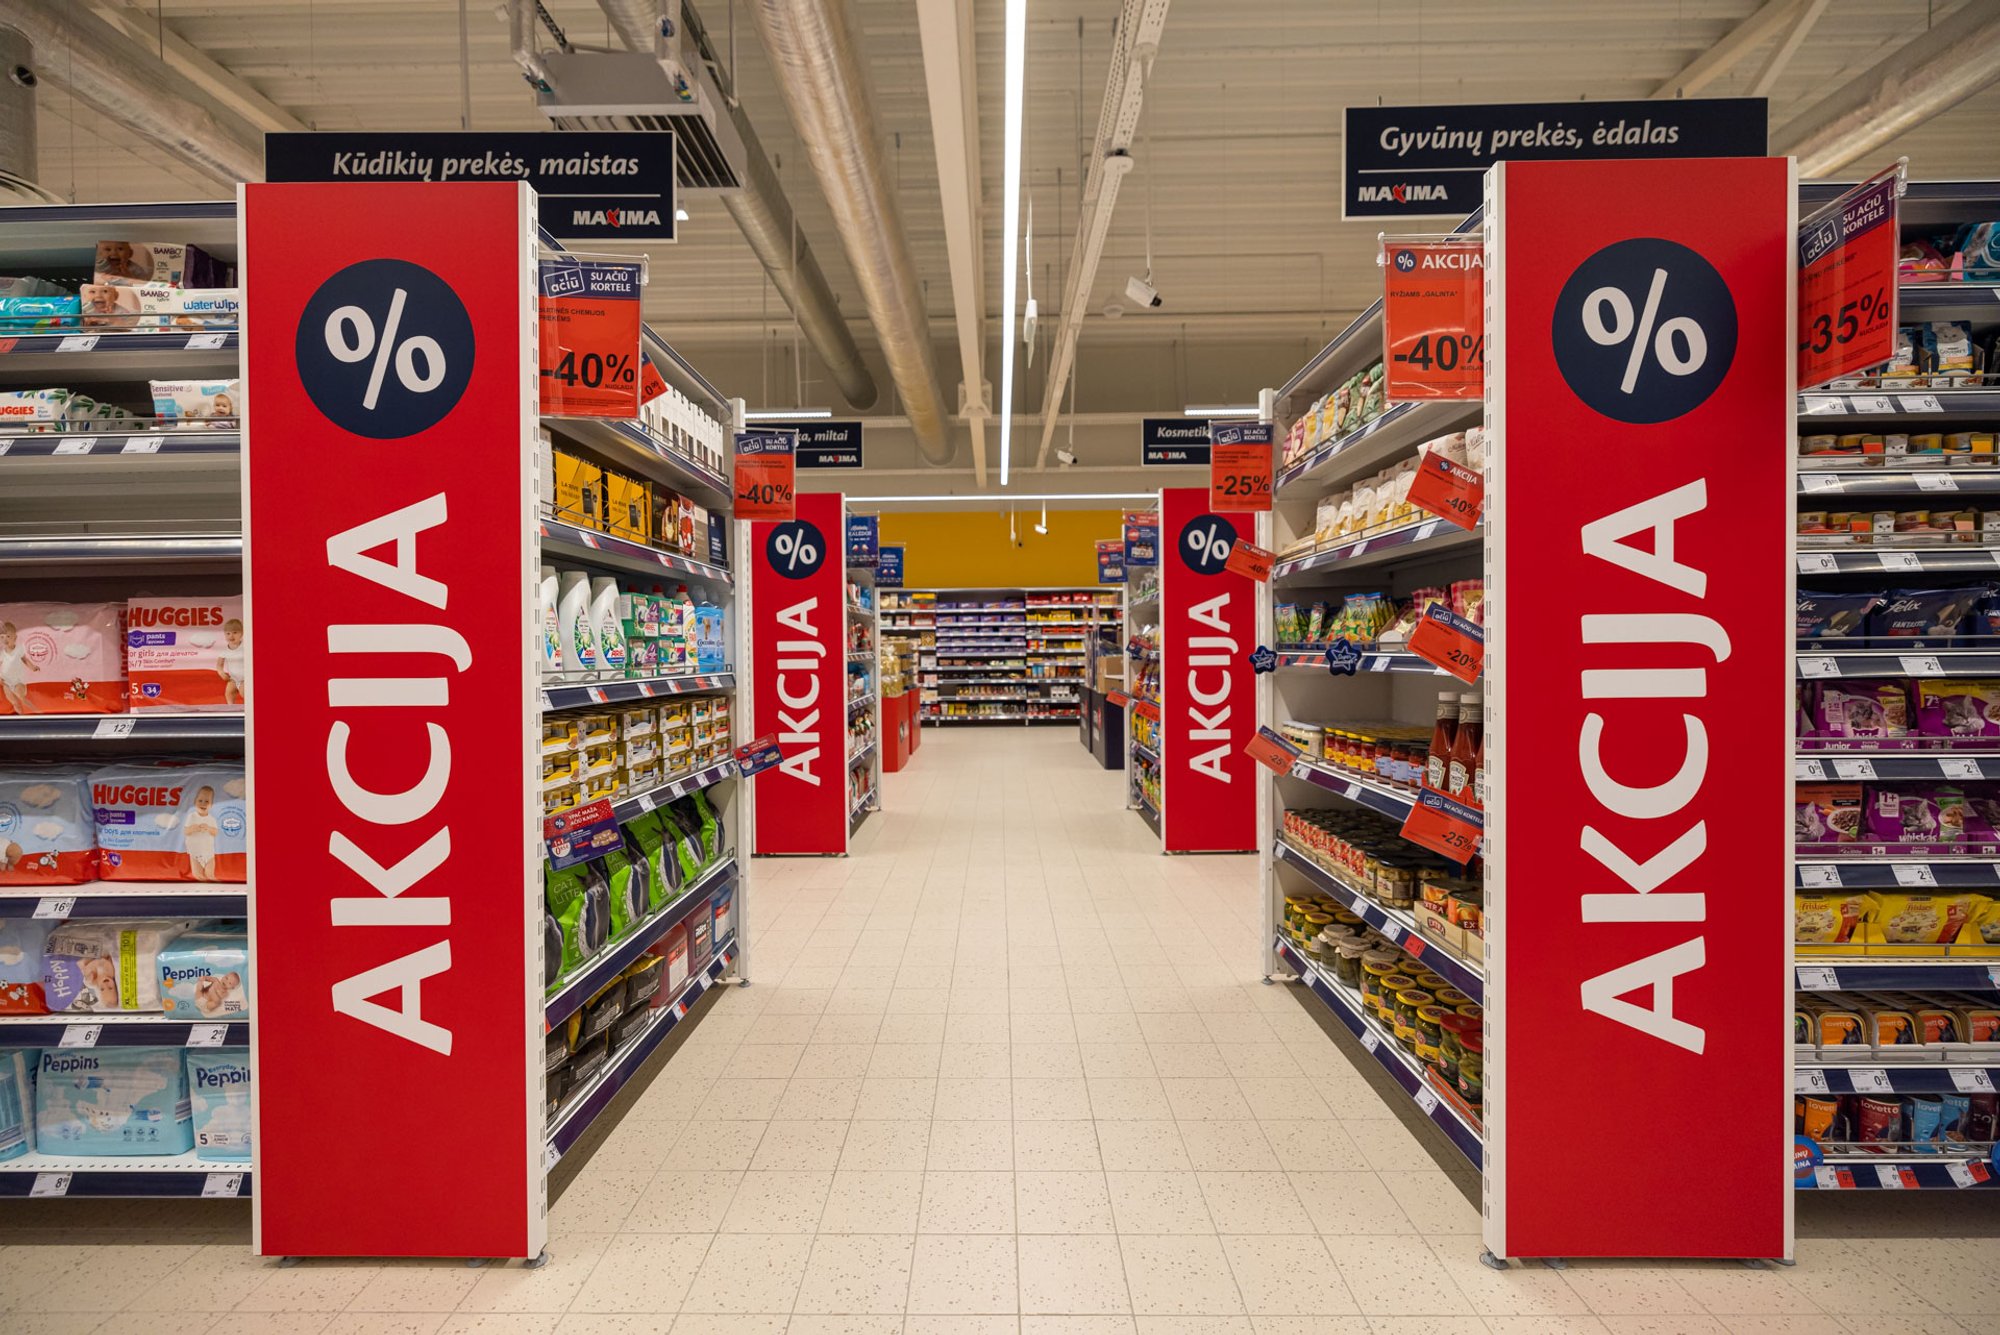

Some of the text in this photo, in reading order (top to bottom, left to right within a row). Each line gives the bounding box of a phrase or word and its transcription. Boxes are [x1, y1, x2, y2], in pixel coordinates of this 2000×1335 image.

[1380, 119, 1679, 156] Gyvūnų prekės, ėdalas
[333, 151, 639, 182] Kūdikių prekės, maistas
[1358, 182, 1448, 204] MAXIMA
[572, 208, 661, 228] MAXIMA
[1843, 194, 1881, 225] SU AČIŪ
[1843, 205, 1885, 236] KORTELE
[153, 247, 182, 255] BAMBO
[1422, 254, 1484, 271] AKCIJA
[591, 270, 628, 282] SU AČIŪ
[140, 290, 170, 298] BAMBO
[591, 283, 631, 292] KORTELE
[1799, 287, 1889, 355] -35%
[540, 351, 635, 389] -40%
[814, 429, 848, 441] miltai
[1215, 475, 1270, 496] -25%
[1450, 466, 1478, 485] AKCIJA
[738, 484, 792, 505] -40%
[1445, 498, 1476, 517] -40%
[128, 606, 223, 627] HUGGIES
[146, 632, 166, 640] pants
[138, 649, 154, 659] girls
[1447, 649, 1478, 671] -20%
[132, 683, 139, 694] 5
[776, 597, 826, 785] AKCIJA
[1187, 593, 1238, 783] AKCIJA
[327, 492, 472, 1056] AKCIJA
[1579, 478, 1731, 1054] AKCIJA
[93, 784, 182, 806] HUGGIES
[1441, 831, 1473, 852] -25%
[553, 879, 573, 894] CAT
[50, 960, 65, 997] Happy
[162, 966, 211, 981] Peppins
[43, 1053, 99, 1073] Peppins
[199, 1133, 208, 1145] 5
